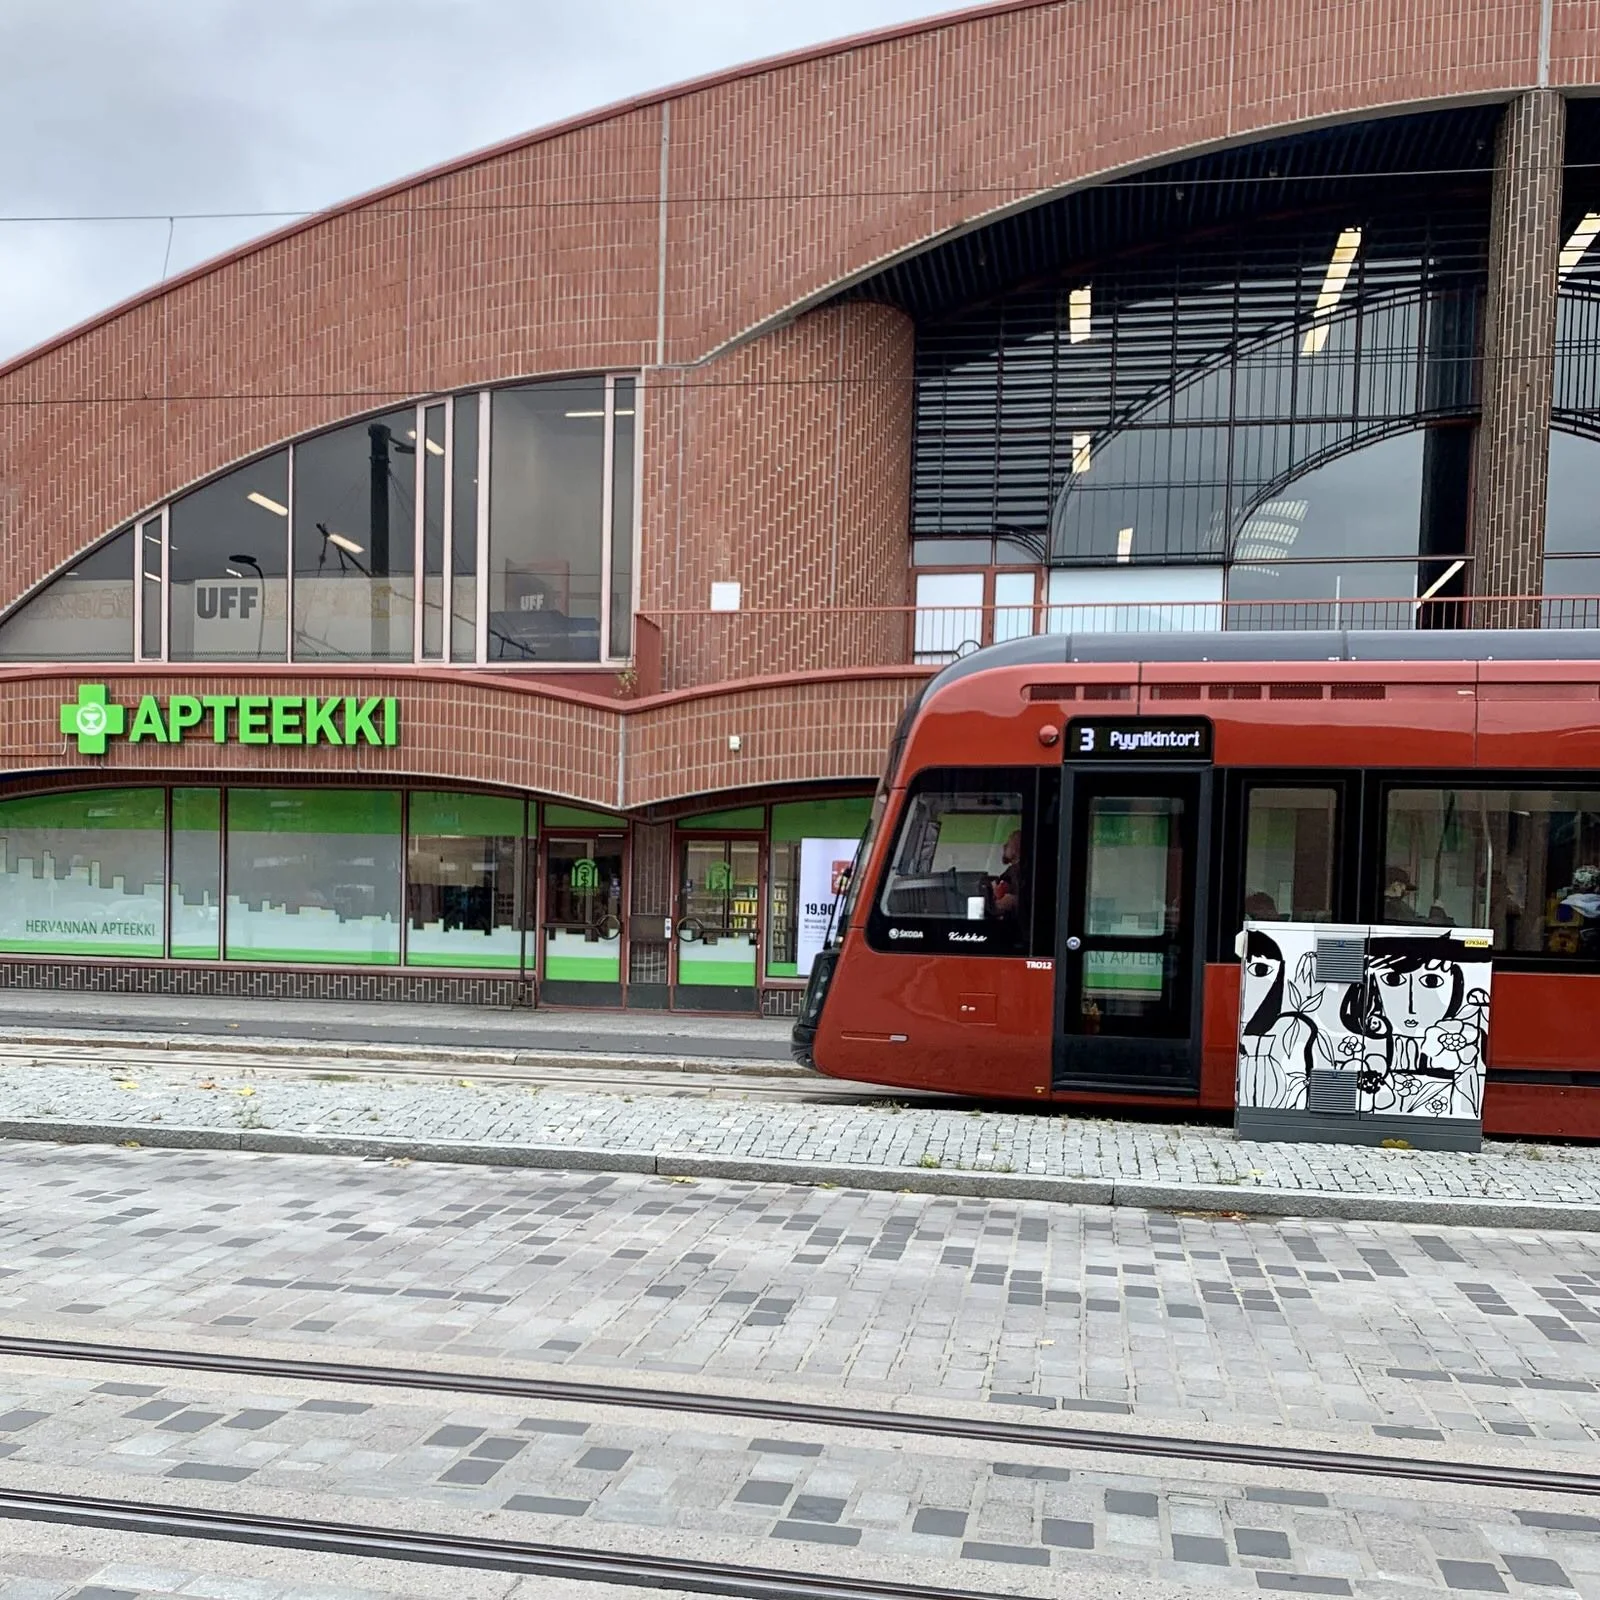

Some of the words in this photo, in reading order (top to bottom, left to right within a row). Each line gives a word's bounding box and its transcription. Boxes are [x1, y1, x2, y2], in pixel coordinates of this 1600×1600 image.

[197, 587, 258, 619] UFF
[520, 594, 545, 611] UFF
[128, 695, 397, 746] APTEEKKI
[1079, 728, 1095, 751] 3
[1110, 730, 1200, 751] Pyynikintori
[25, 920, 97, 934] HERVANNAN
[101, 922, 156, 936] APTEEKKI
[948, 931, 987, 942] Kukka
